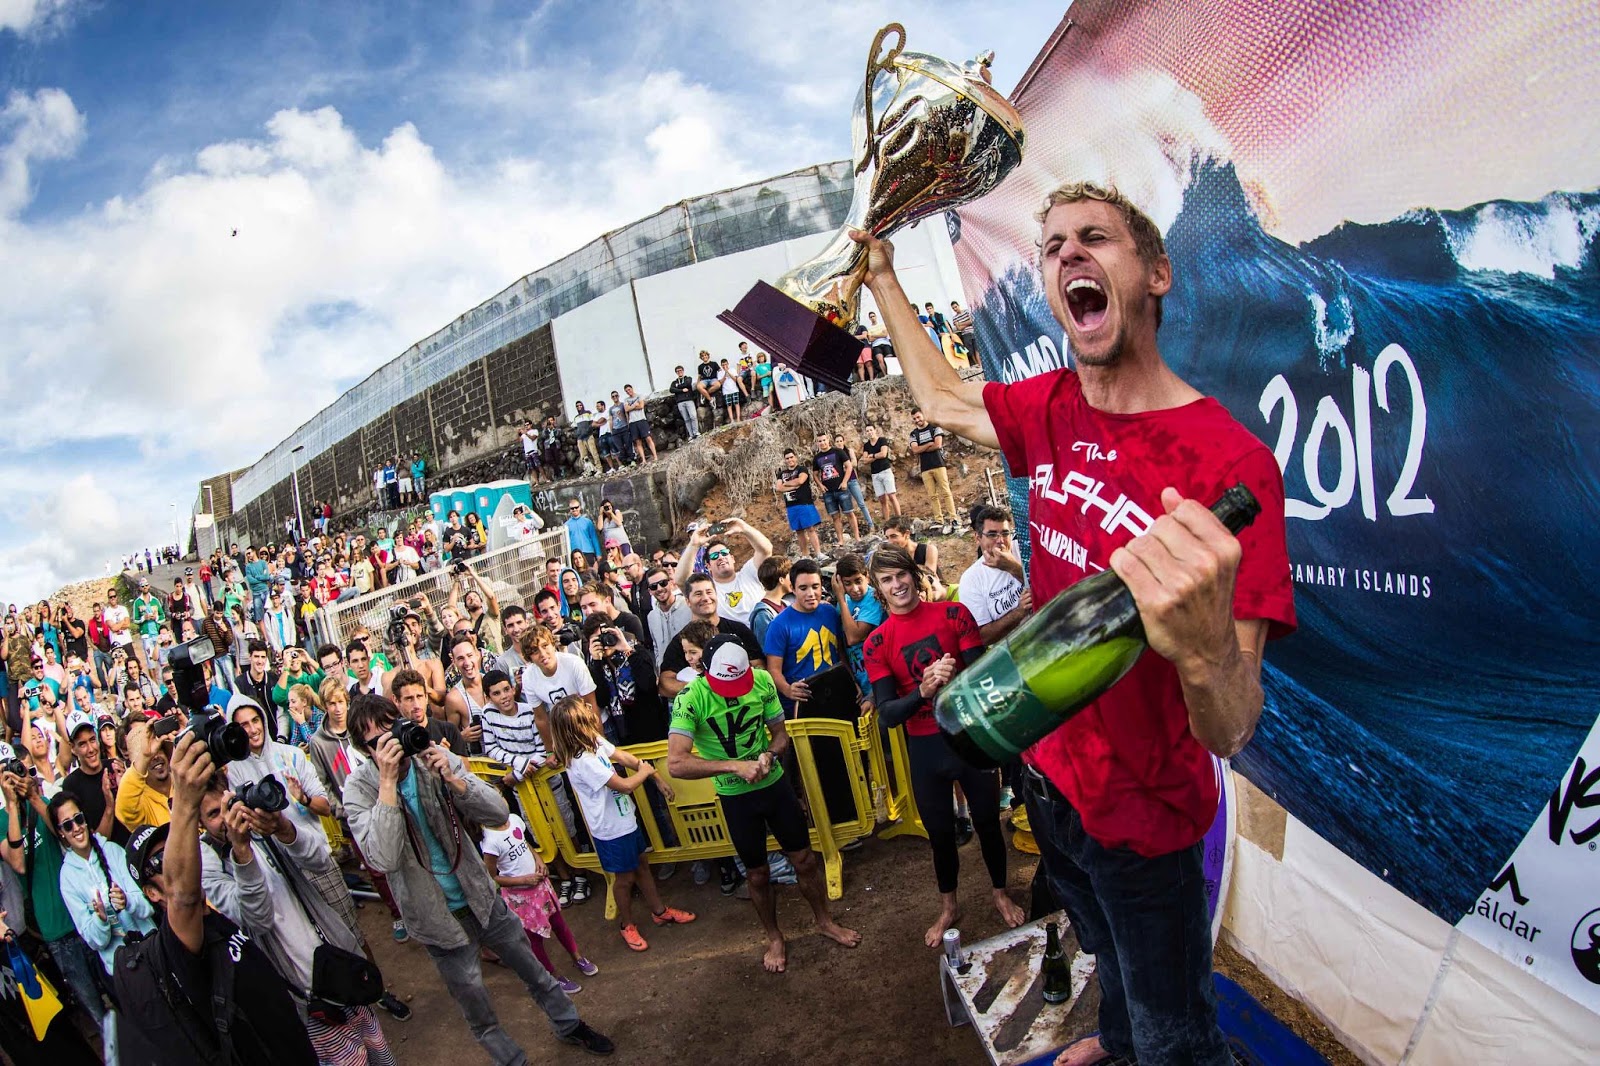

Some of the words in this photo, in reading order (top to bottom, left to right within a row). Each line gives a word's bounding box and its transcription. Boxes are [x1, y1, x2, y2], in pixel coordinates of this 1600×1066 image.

[1072, 441, 1117, 462] The
[1258, 343, 1435, 521] 2012
[1040, 524, 1088, 573] CAMPAIGN
[1355, 569, 1431, 598] ISLANDS
[706, 705, 761, 758] VS
